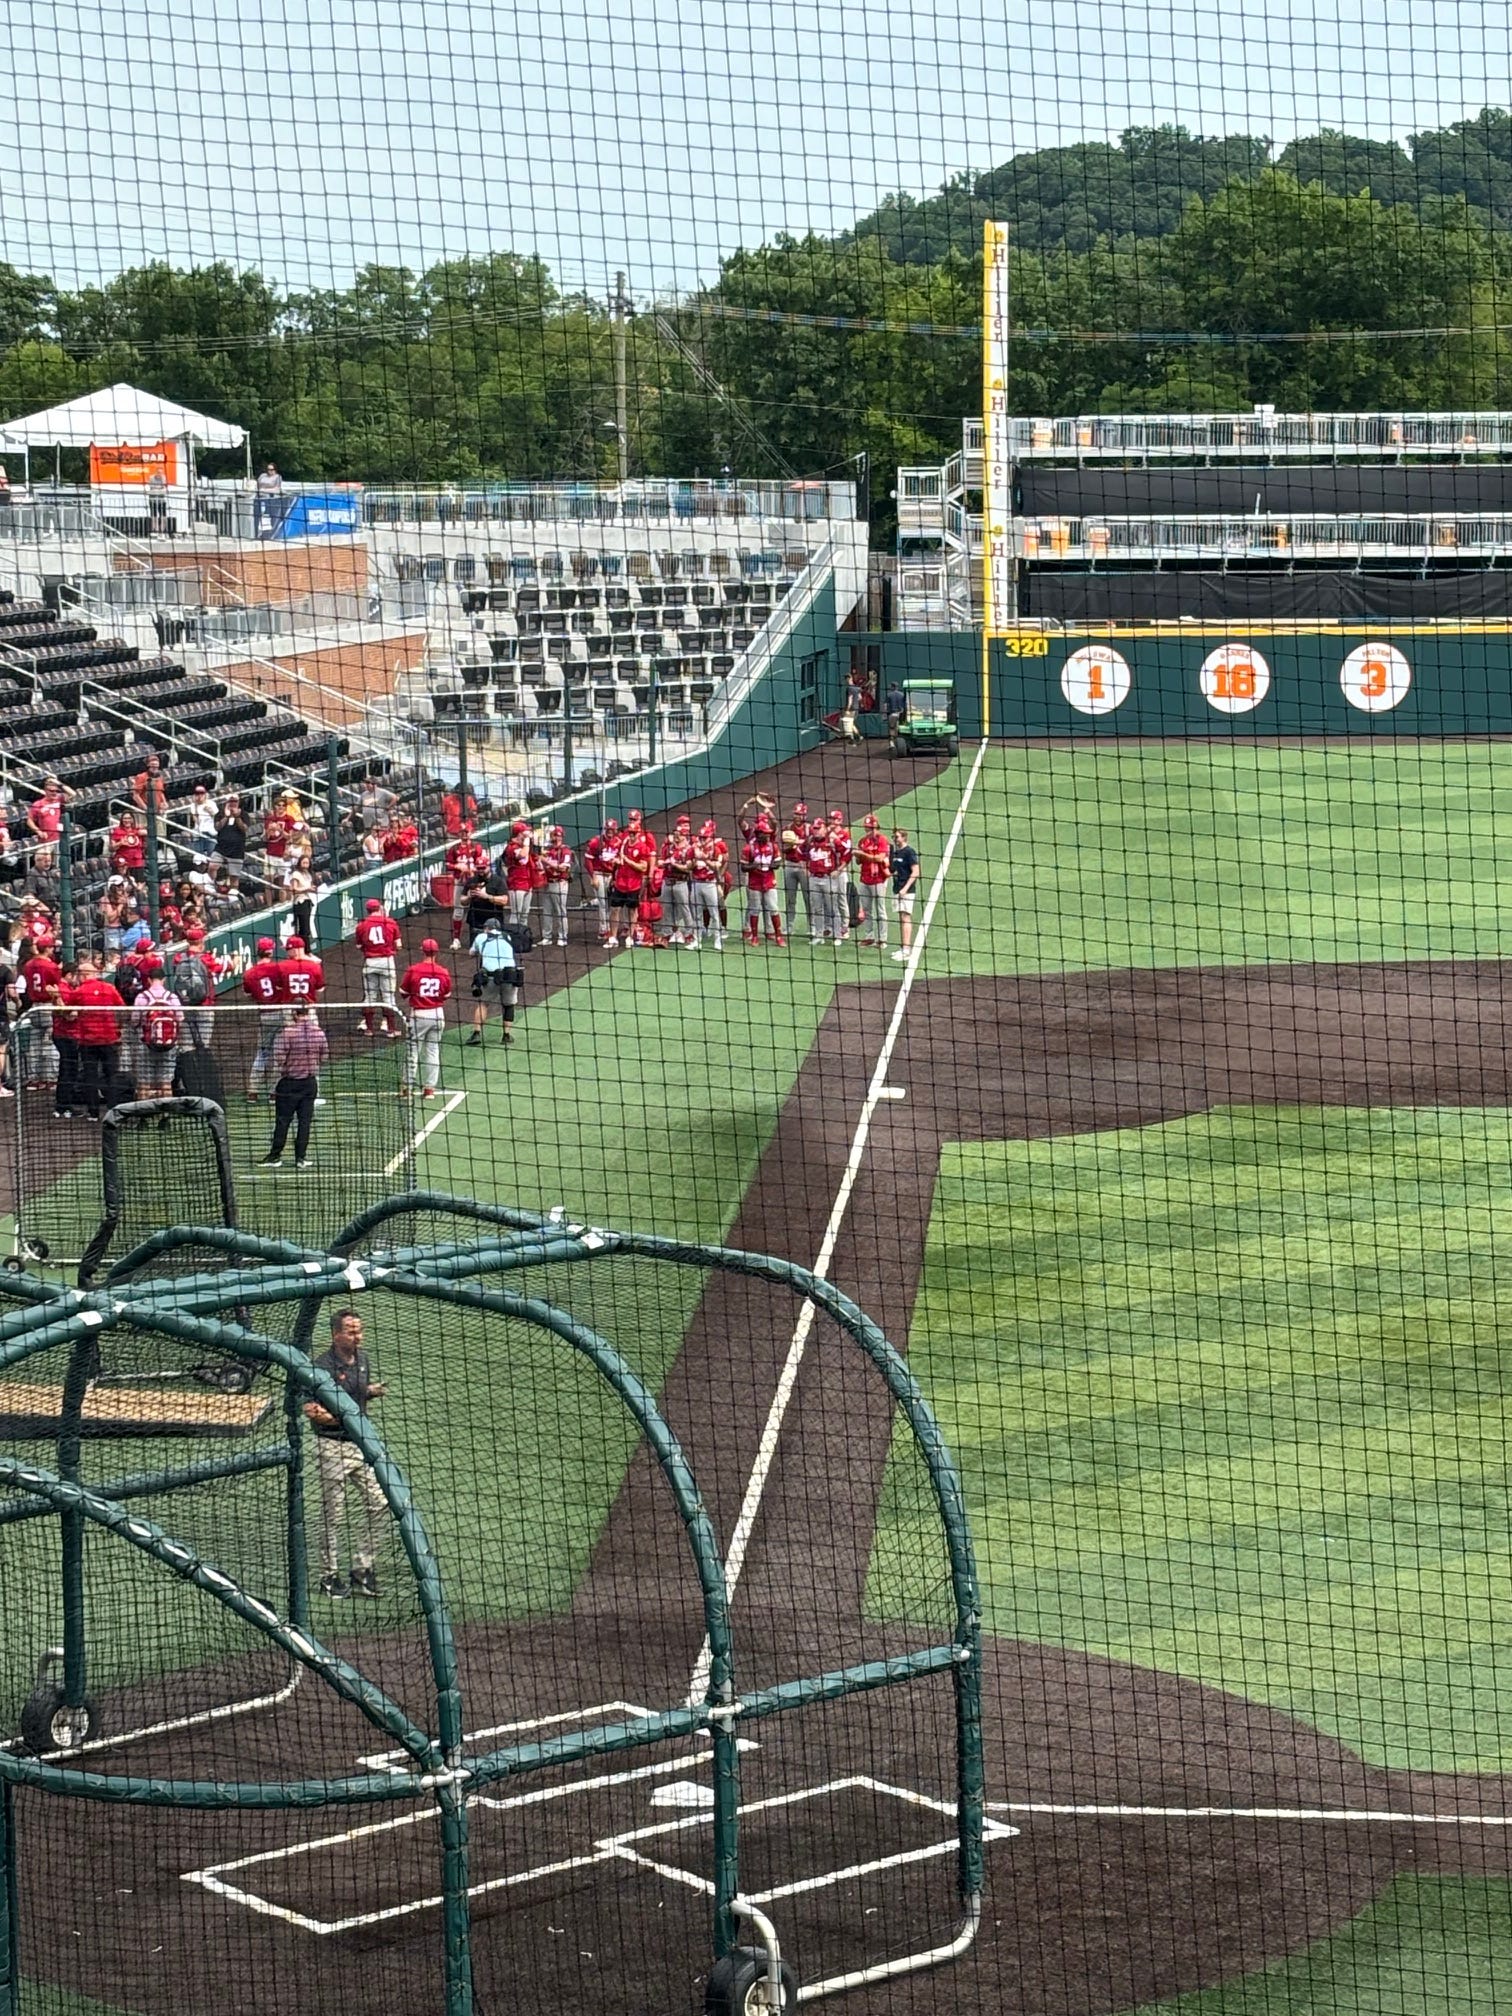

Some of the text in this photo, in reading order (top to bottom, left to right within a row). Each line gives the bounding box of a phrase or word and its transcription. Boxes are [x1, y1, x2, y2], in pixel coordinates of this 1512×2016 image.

[991, 396, 1003, 489] Hiller
[1005, 638, 1048, 657] 320
[1087, 665, 1105, 699] 1
[1213, 664, 1256, 698] 18
[1360, 661, 1387, 697] 3
[369, 925, 385, 945] 41
[33, 973, 42, 992] 2
[260, 976, 274, 997] 9
[288, 973, 310, 995] 55
[419, 977, 440, 997] 22
